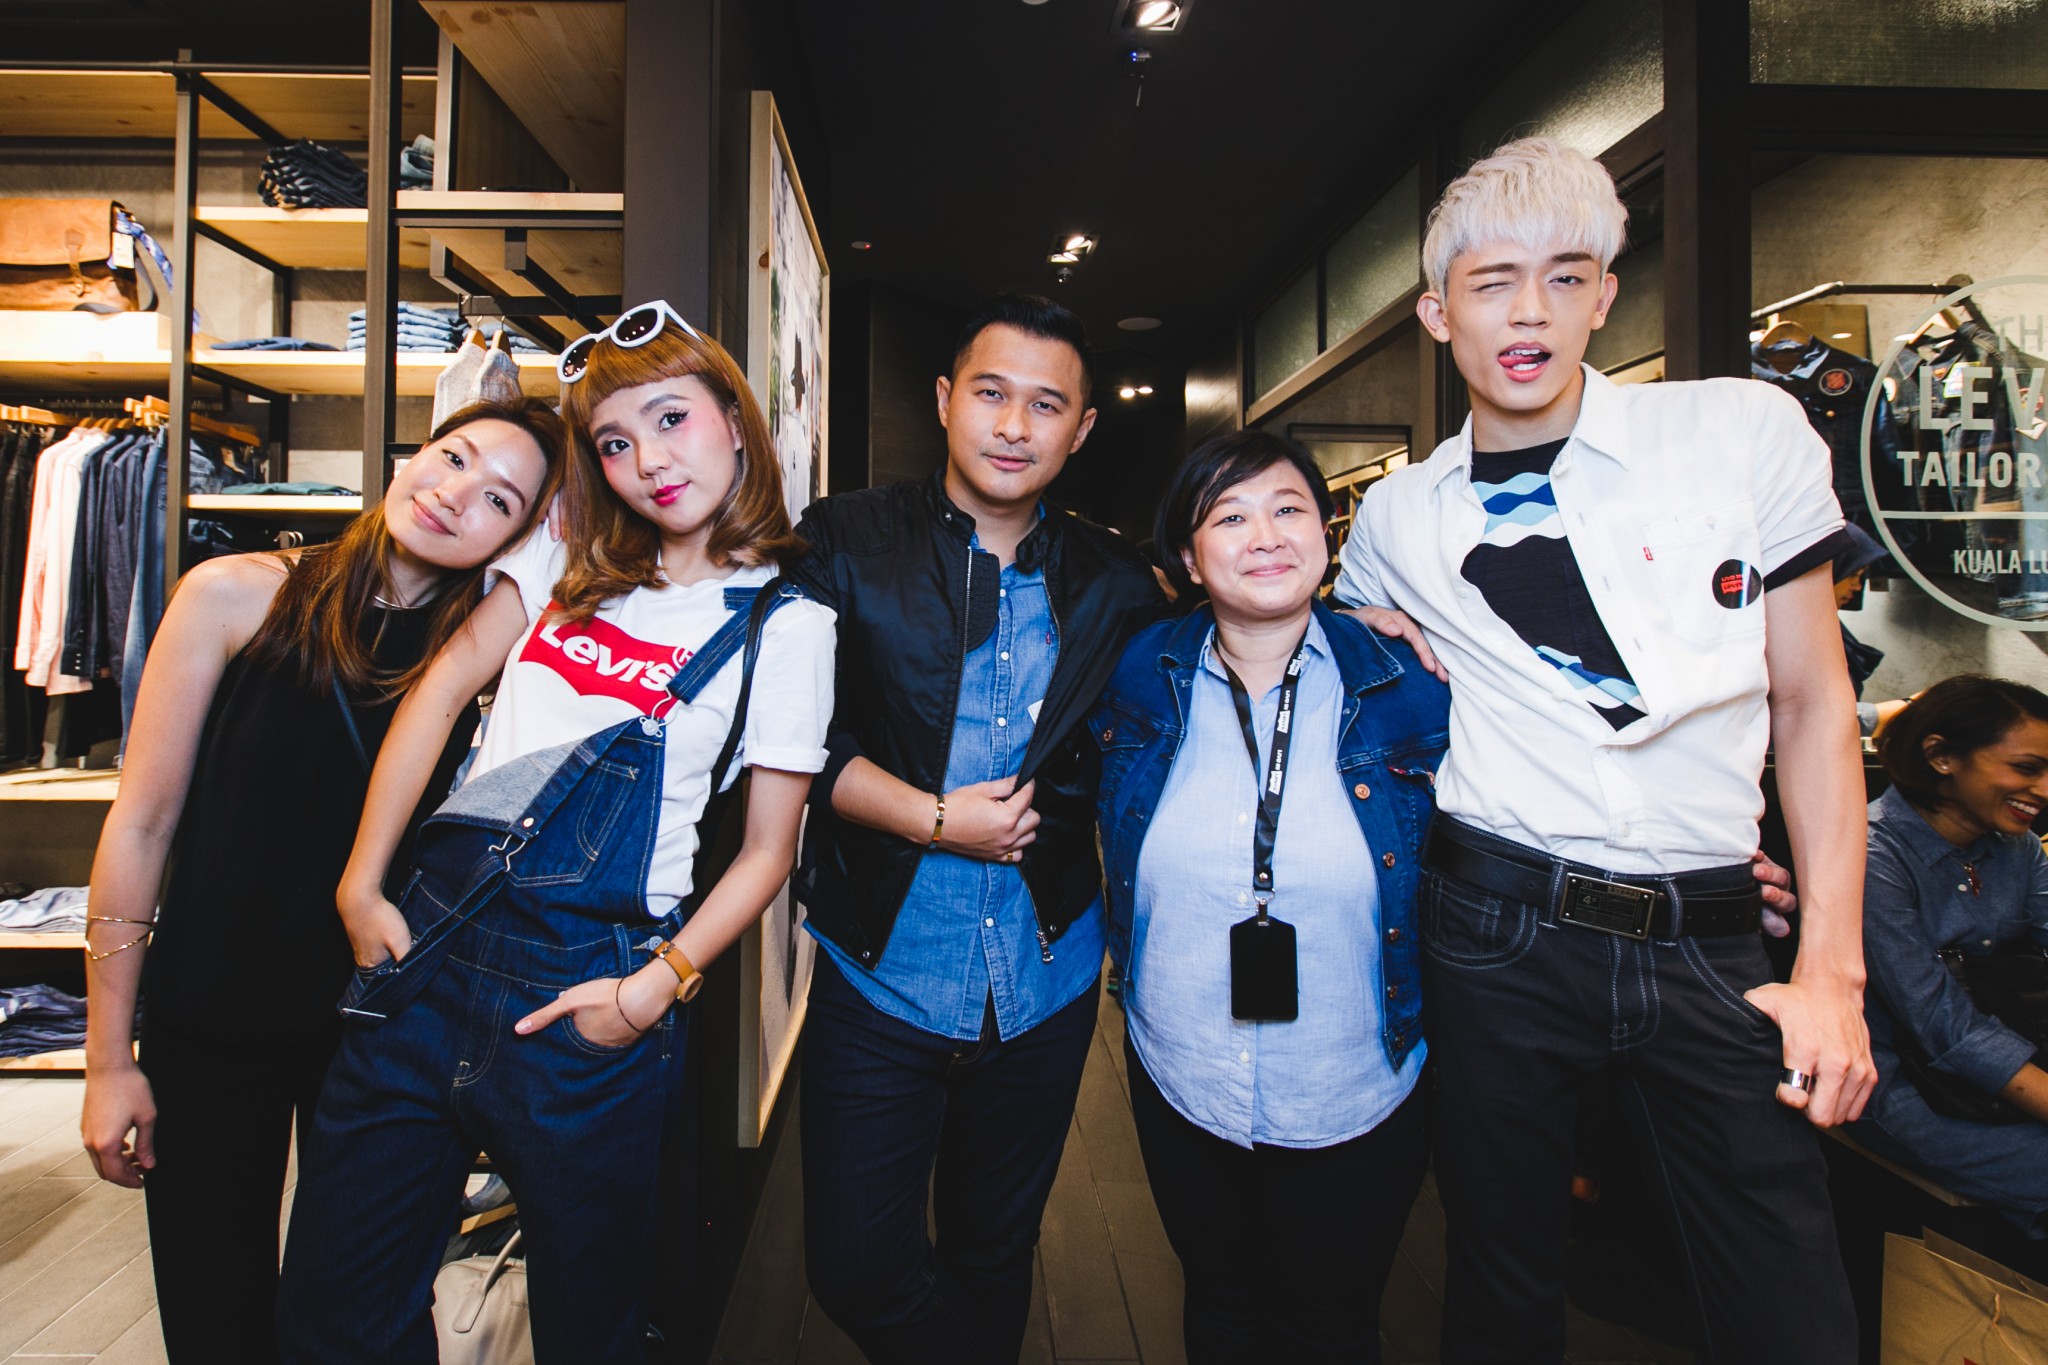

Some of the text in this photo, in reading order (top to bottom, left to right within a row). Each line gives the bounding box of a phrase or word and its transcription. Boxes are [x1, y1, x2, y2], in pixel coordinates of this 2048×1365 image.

[1919, 366, 2046, 430] LEV
[1896, 451, 2042, 488] TAILOR
[1954, 549, 2022, 574] KUALA
